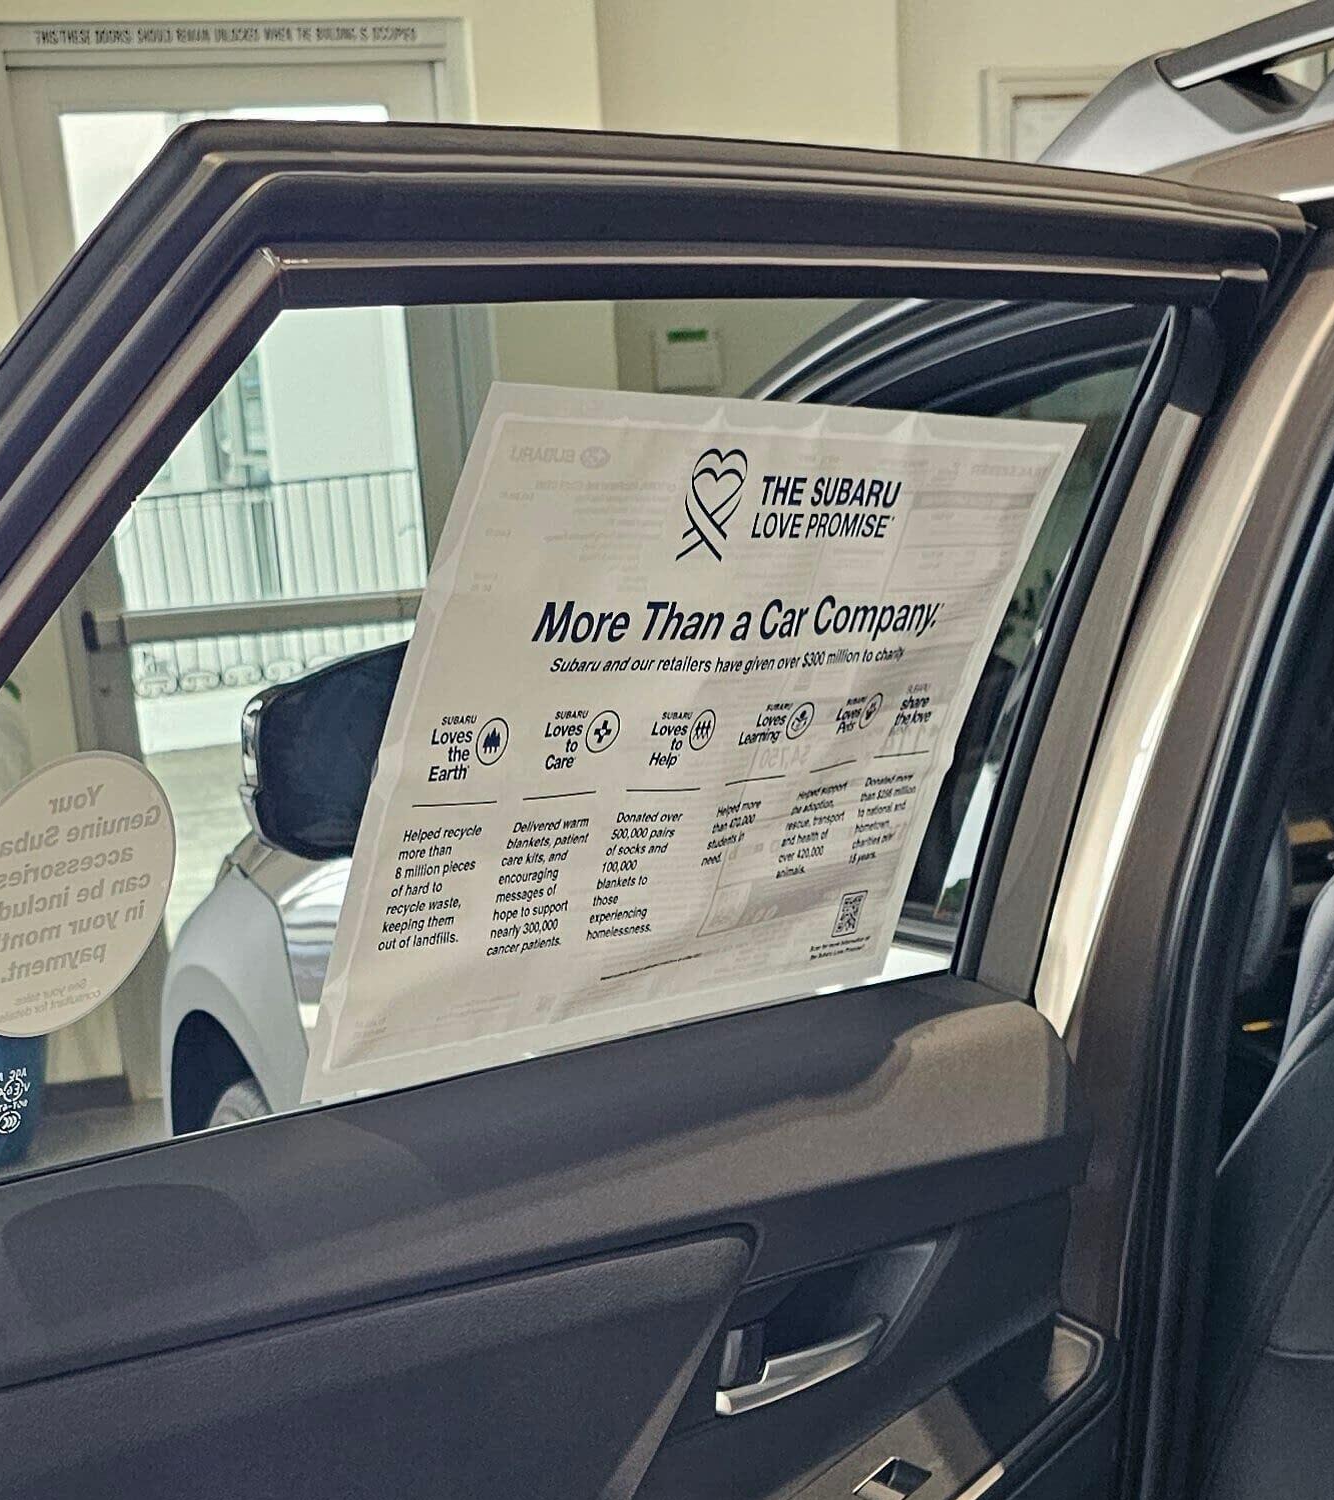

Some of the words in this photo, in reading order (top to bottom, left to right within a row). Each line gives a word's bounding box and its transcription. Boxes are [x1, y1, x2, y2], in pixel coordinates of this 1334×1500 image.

[761, 475, 808, 506] THE
[810, 476, 902, 508] SUBARU
[751, 512, 804, 539] LOVE
[805, 512, 890, 539] PROMISE
[531, 600, 631, 643] More
[641, 600, 725, 641] Than
[729, 611, 752, 641] a
[759, 598, 810, 641] Car
[813, 594, 941, 642] Company.
[549, 656, 601, 673] Subaru
[602, 656, 631, 672] and
[630, 658, 656, 672] our
[656, 656, 712, 673] retailers
[714, 656, 743, 673] have
[744, 655, 775, 675] given
[776, 656, 801, 668] over
[801, 650, 826, 668] $300
[826, 647, 860, 665] million
[861, 648, 873, 663] to
[899, 695, 930, 711] share
[441, 715, 478, 726] SUBARU
[555, 710, 589, 720] SUBARU
[661, 711, 693, 720] SUBARU
[755, 713, 787, 728] Loves
[835, 707, 862, 722] Loves
[893, 712, 912, 728] the
[910, 709, 932, 724] love
[430, 728, 473, 745] Loves
[544, 722, 584, 738] Loves
[650, 721, 689, 737] Loves
[737, 727, 781, 746] Learning
[566, 738, 579, 753] to
[670, 737, 683, 751] to
[447, 746, 470, 763] the
[545, 754, 575, 770] Care
[648, 752, 678, 769] Help
[428, 764, 468, 782] Earth
[616, 811, 659, 824] Donated
[660, 813, 683, 823] over
[716, 801, 741, 818] Helped
[741, 800, 762, 811] more
[512, 819, 562, 834] Delivered
[562, 818, 589, 829] warm
[812, 810, 845, 827] transport
[403, 827, 442, 843] Helped
[443, 824, 482, 840] recycle
[610, 827, 649, 841] 500,000
[648, 828, 675, 841] pairs
[711, 822, 728, 835] than
[506, 837, 552, 850] blankets,
[553, 833, 589, 849] patient
[605, 844, 618, 857] of
[617, 843, 646, 856] socks
[647, 842, 669, 855] and
[706, 834, 737, 851] students
[737, 831, 745, 843] in
[780, 835, 797, 848] and
[398, 848, 426, 860] more
[428, 845, 452, 857] than
[501, 854, 524, 867] care
[525, 852, 546, 865] kits,
[548, 849, 569, 862] and
[778, 852, 796, 864] over
[394, 866, 403, 879] 8
[404, 863, 441, 879] million
[442, 860, 476, 877] pieces
[602, 859, 637, 874] 100,000
[498, 867, 559, 886] encouraging
[596, 876, 636, 890] blankets
[637, 874, 648, 886] to
[390, 884, 404, 898] of
[405, 882, 431, 897] hard
[432, 881, 443, 894] to
[495, 887, 545, 904] messages
[546, 883, 557, 897] of
[386, 901, 427, 917] recycle
[428, 897, 462, 910] waste,
[592, 895, 619, 907] those
[492, 908, 518, 923] hope
[520, 905, 531, 918] to
[532, 900, 569, 917] support
[589, 907, 647, 925] experiencing
[381, 918, 426, 935] keeping
[427, 916, 455, 928] them
[490, 922, 521, 940] nearly
[522, 918, 559, 935] 300,000
[586, 923, 652, 941] homelessness.
[378, 939, 397, 951] out
[398, 935, 411, 949] of
[412, 931, 459, 947] landfills.
[486, 941, 520, 957] cancer
[520, 935, 562, 955] patients.
